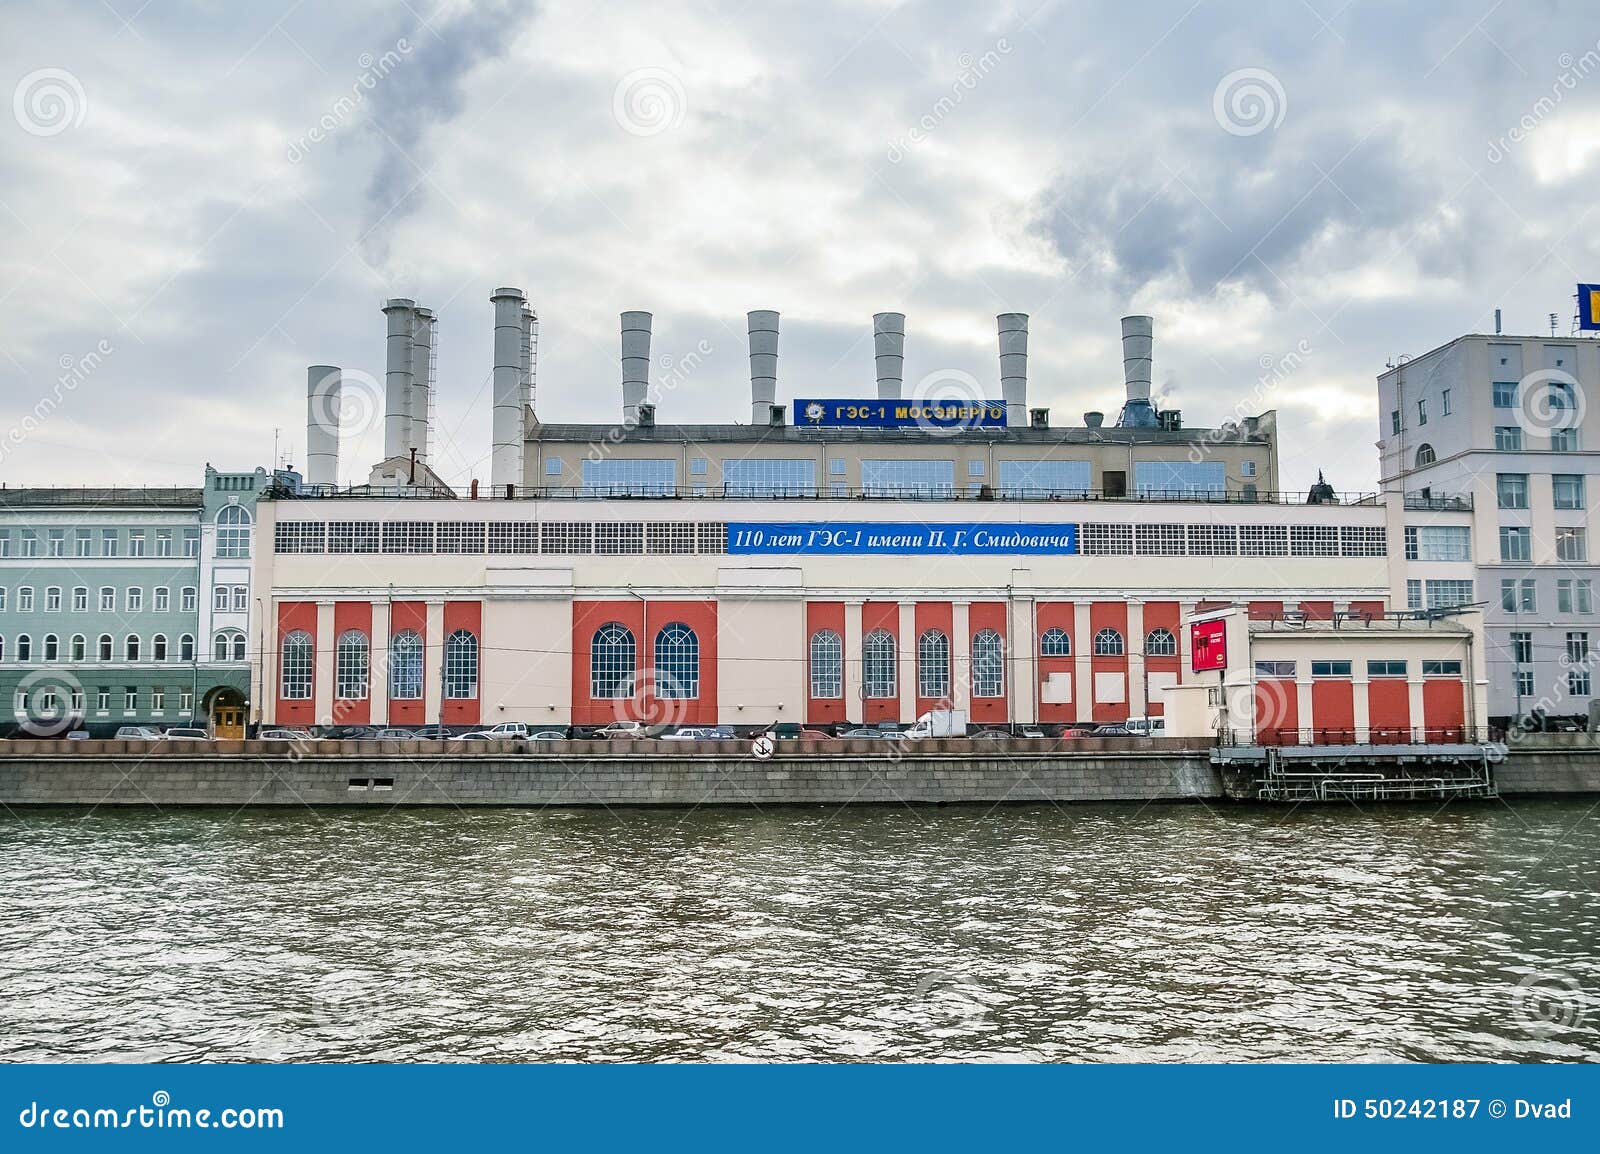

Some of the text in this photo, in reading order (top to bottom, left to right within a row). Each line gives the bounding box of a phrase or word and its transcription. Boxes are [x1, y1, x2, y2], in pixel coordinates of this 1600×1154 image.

[835, 406, 1002, 419] ГЭС-1 МОСЭНЕРГО
[734, 530, 1069, 547] 110 лет ГЭС-1 имени П. Г. Смидовича
